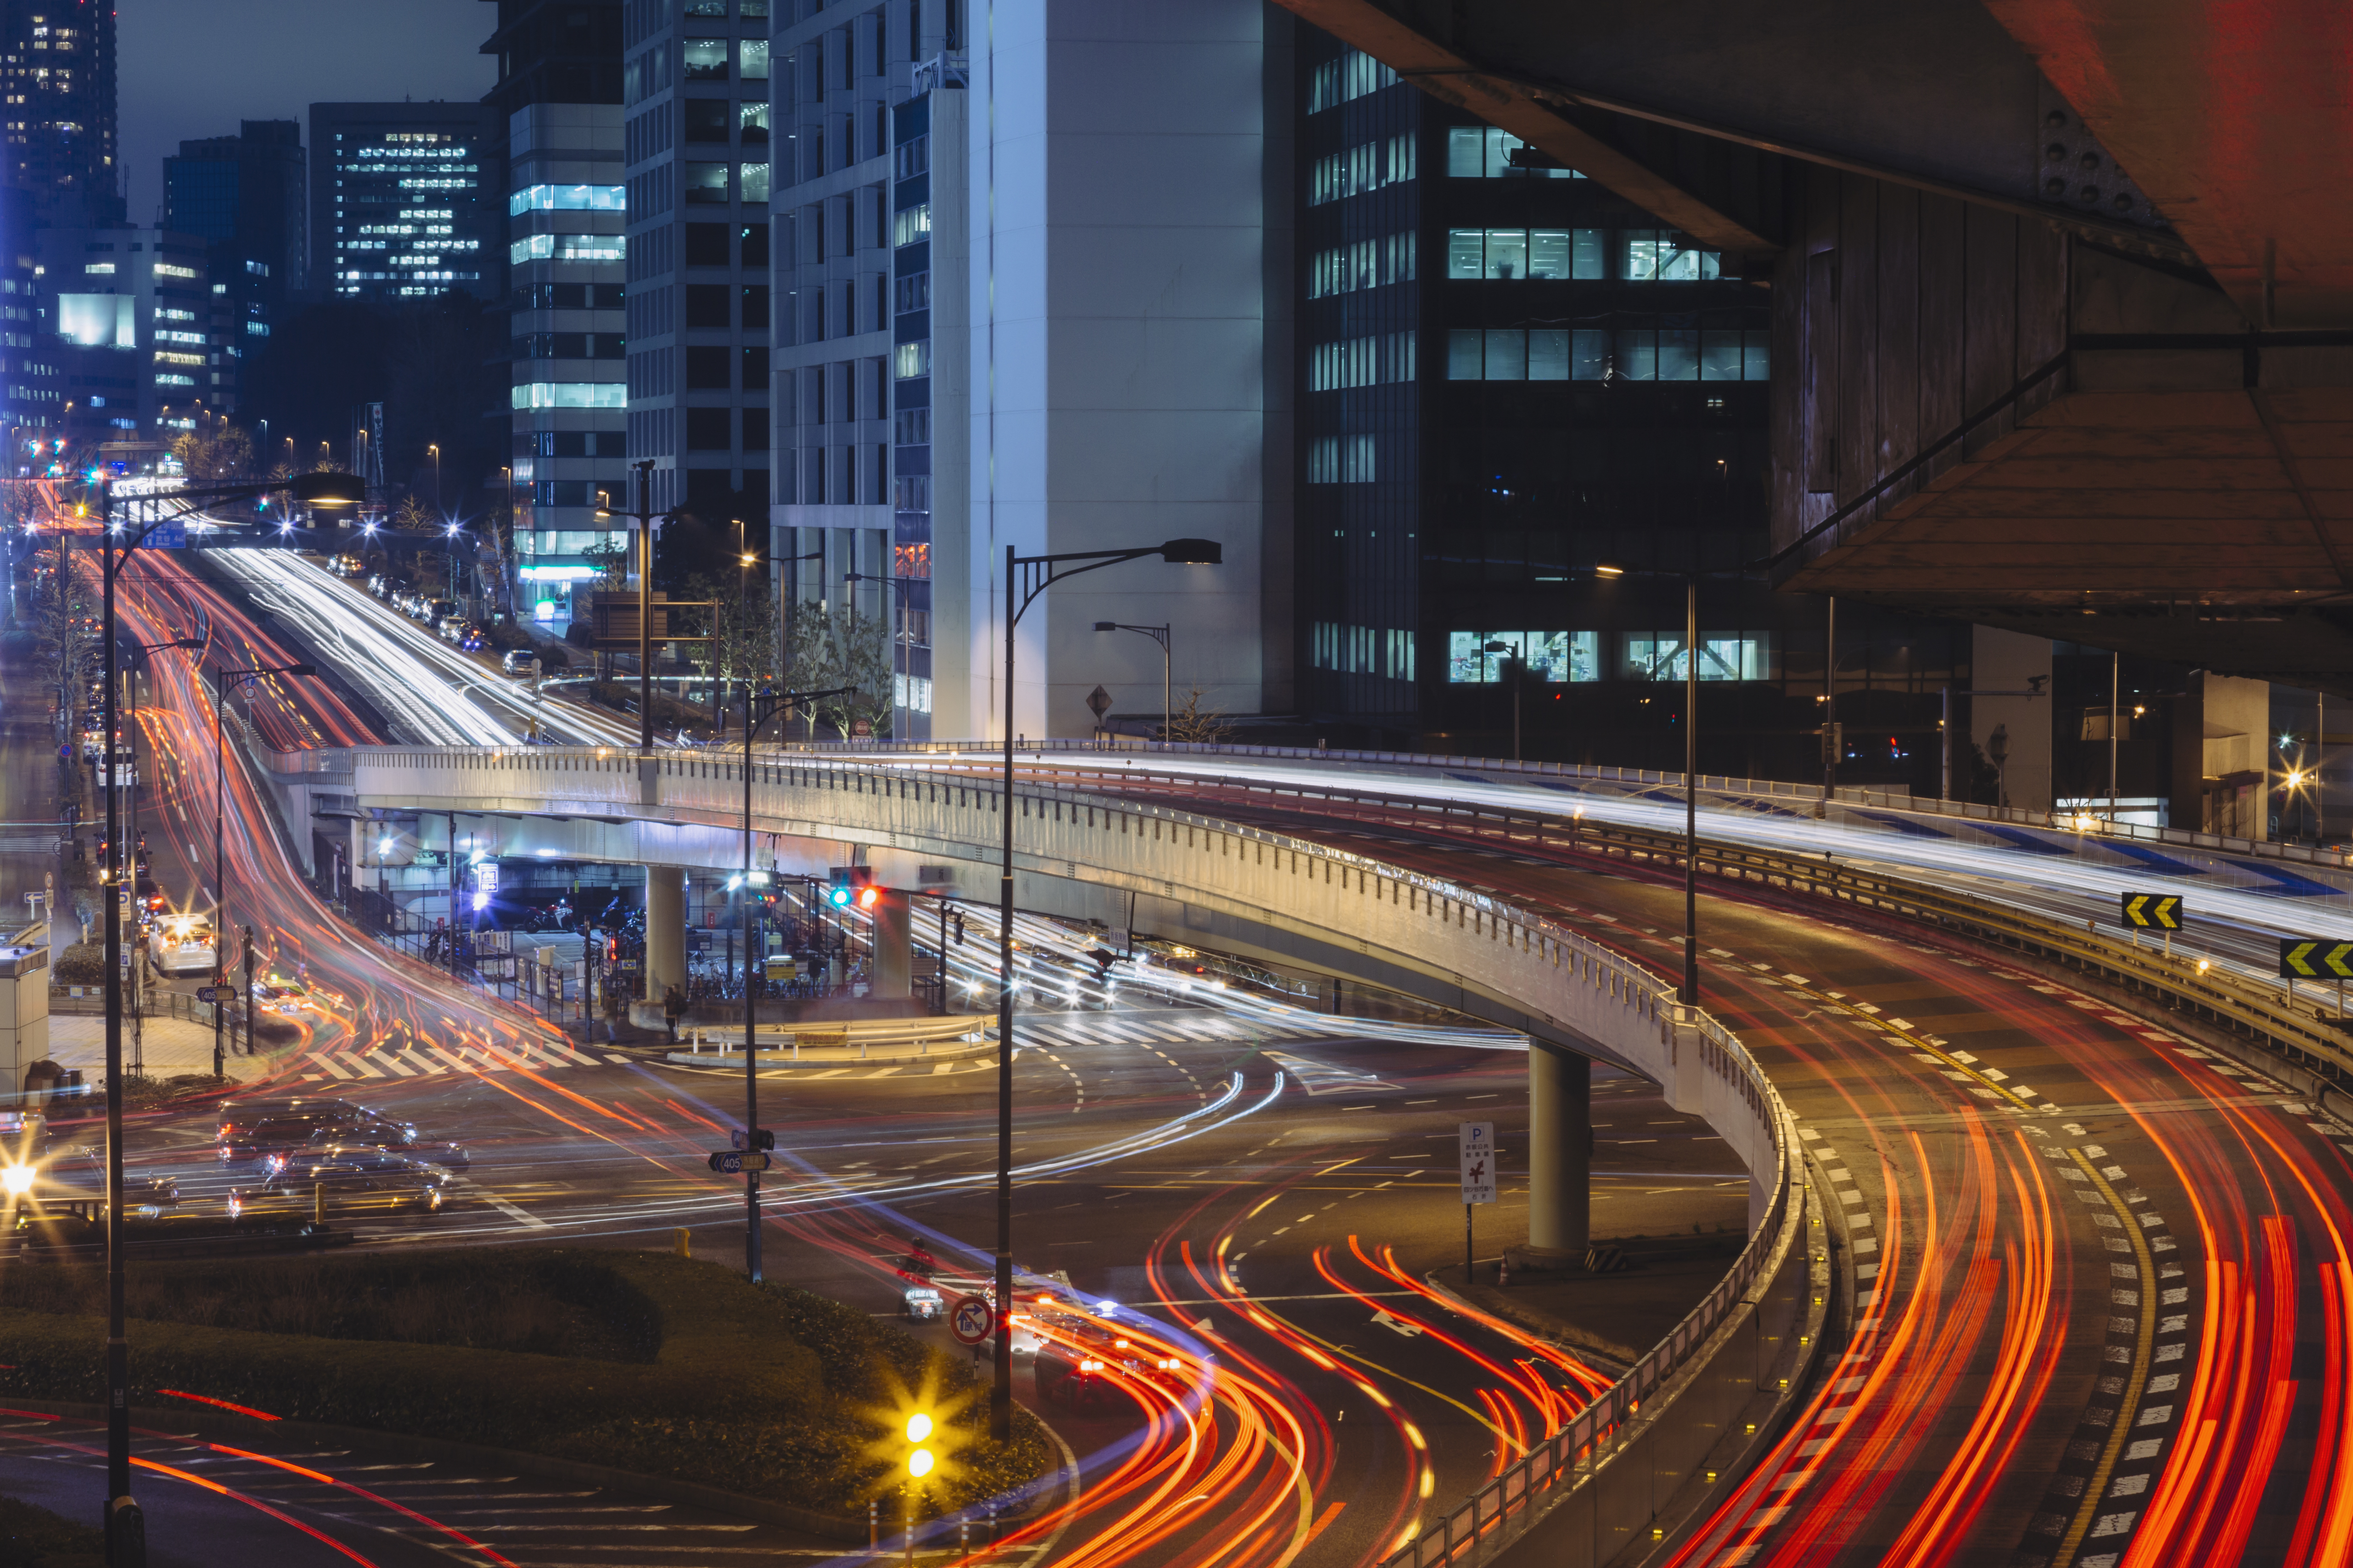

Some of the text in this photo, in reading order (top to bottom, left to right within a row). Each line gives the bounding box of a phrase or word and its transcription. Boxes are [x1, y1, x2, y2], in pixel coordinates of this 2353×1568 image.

[1473, 1128, 1481, 1141] P
[724, 1158, 740, 1169] 405
[964, 1321, 983, 1332] 原付
